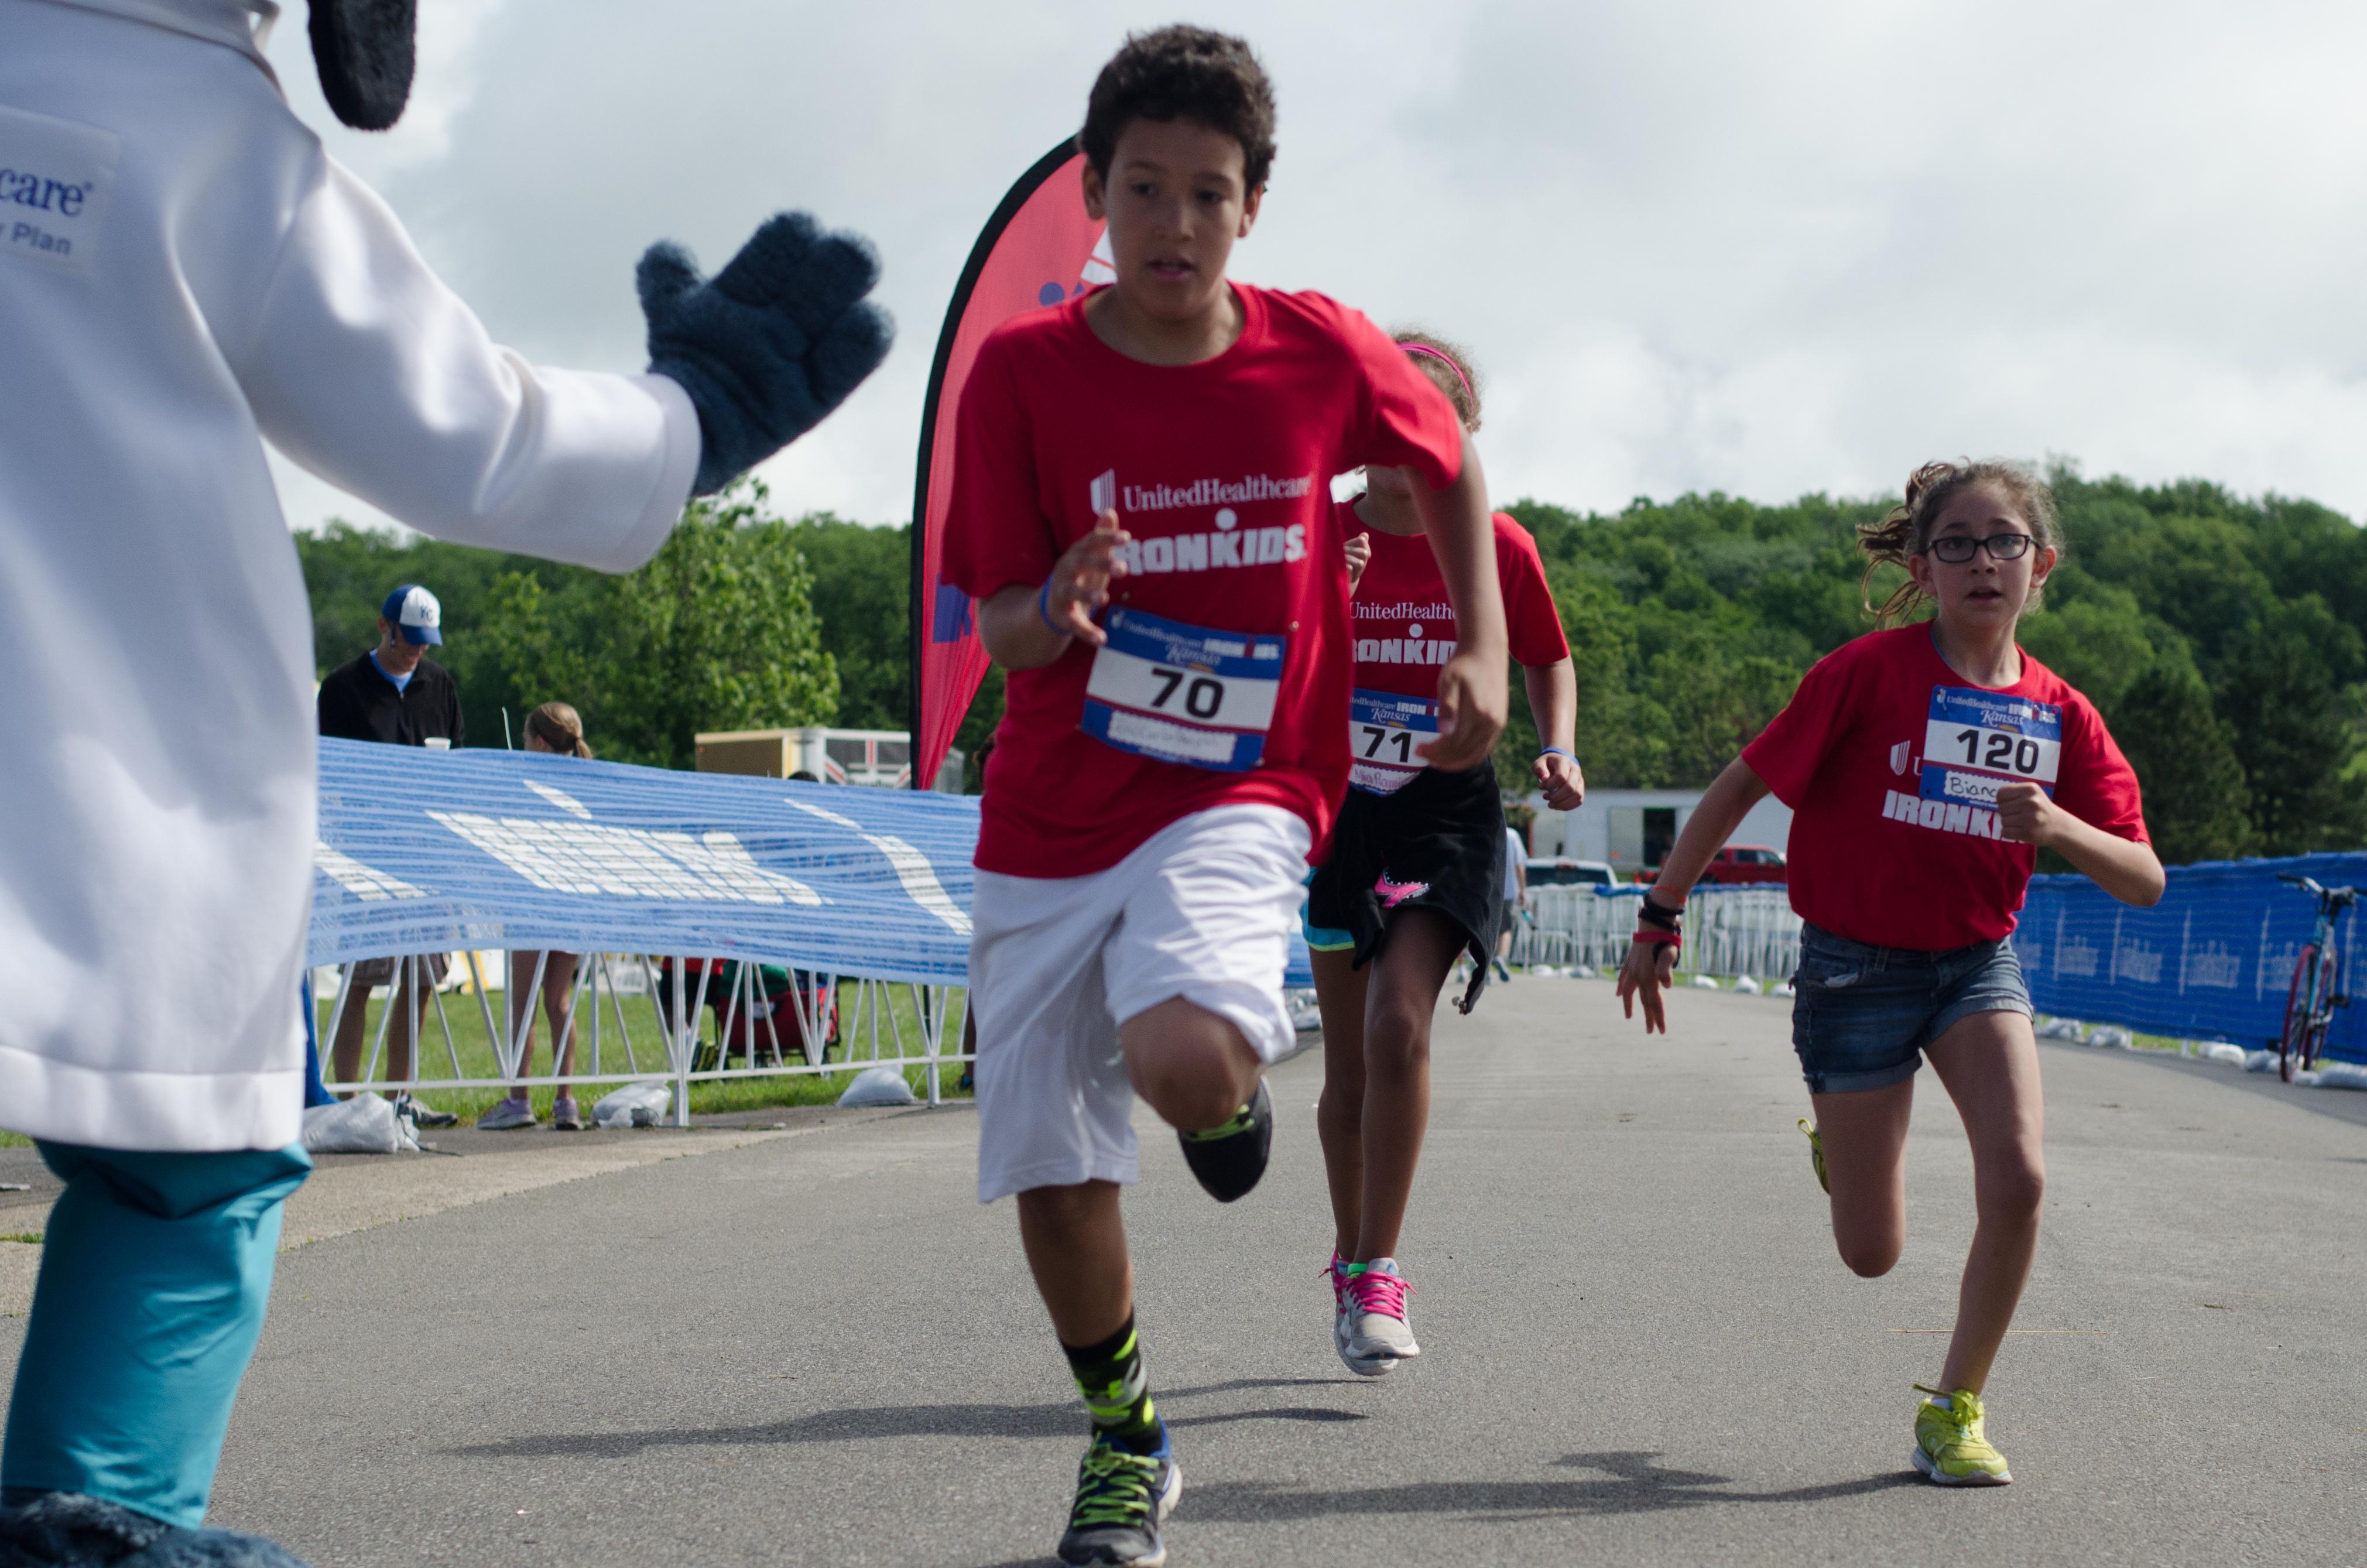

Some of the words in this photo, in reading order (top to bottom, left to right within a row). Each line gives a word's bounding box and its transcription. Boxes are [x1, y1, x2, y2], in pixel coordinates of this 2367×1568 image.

[12, 221, 71, 256] Plan
[1123, 473, 1313, 512] UnitedHealthcare
[1114, 523, 1307, 576] RONKIDS
[1349, 602, 1456, 619] UnitedHealth
[1352, 638, 1458, 665] ONKID
[1152, 667, 1224, 719] 70
[1371, 707, 1412, 724] Kansas
[1981, 709, 2024, 727] Kansas
[1363, 725, 1412, 763] 71
[1957, 729, 2039, 774] 120
[1950, 776, 1998, 797] Bianc
[1881, 789, 2025, 844] IRONKI
